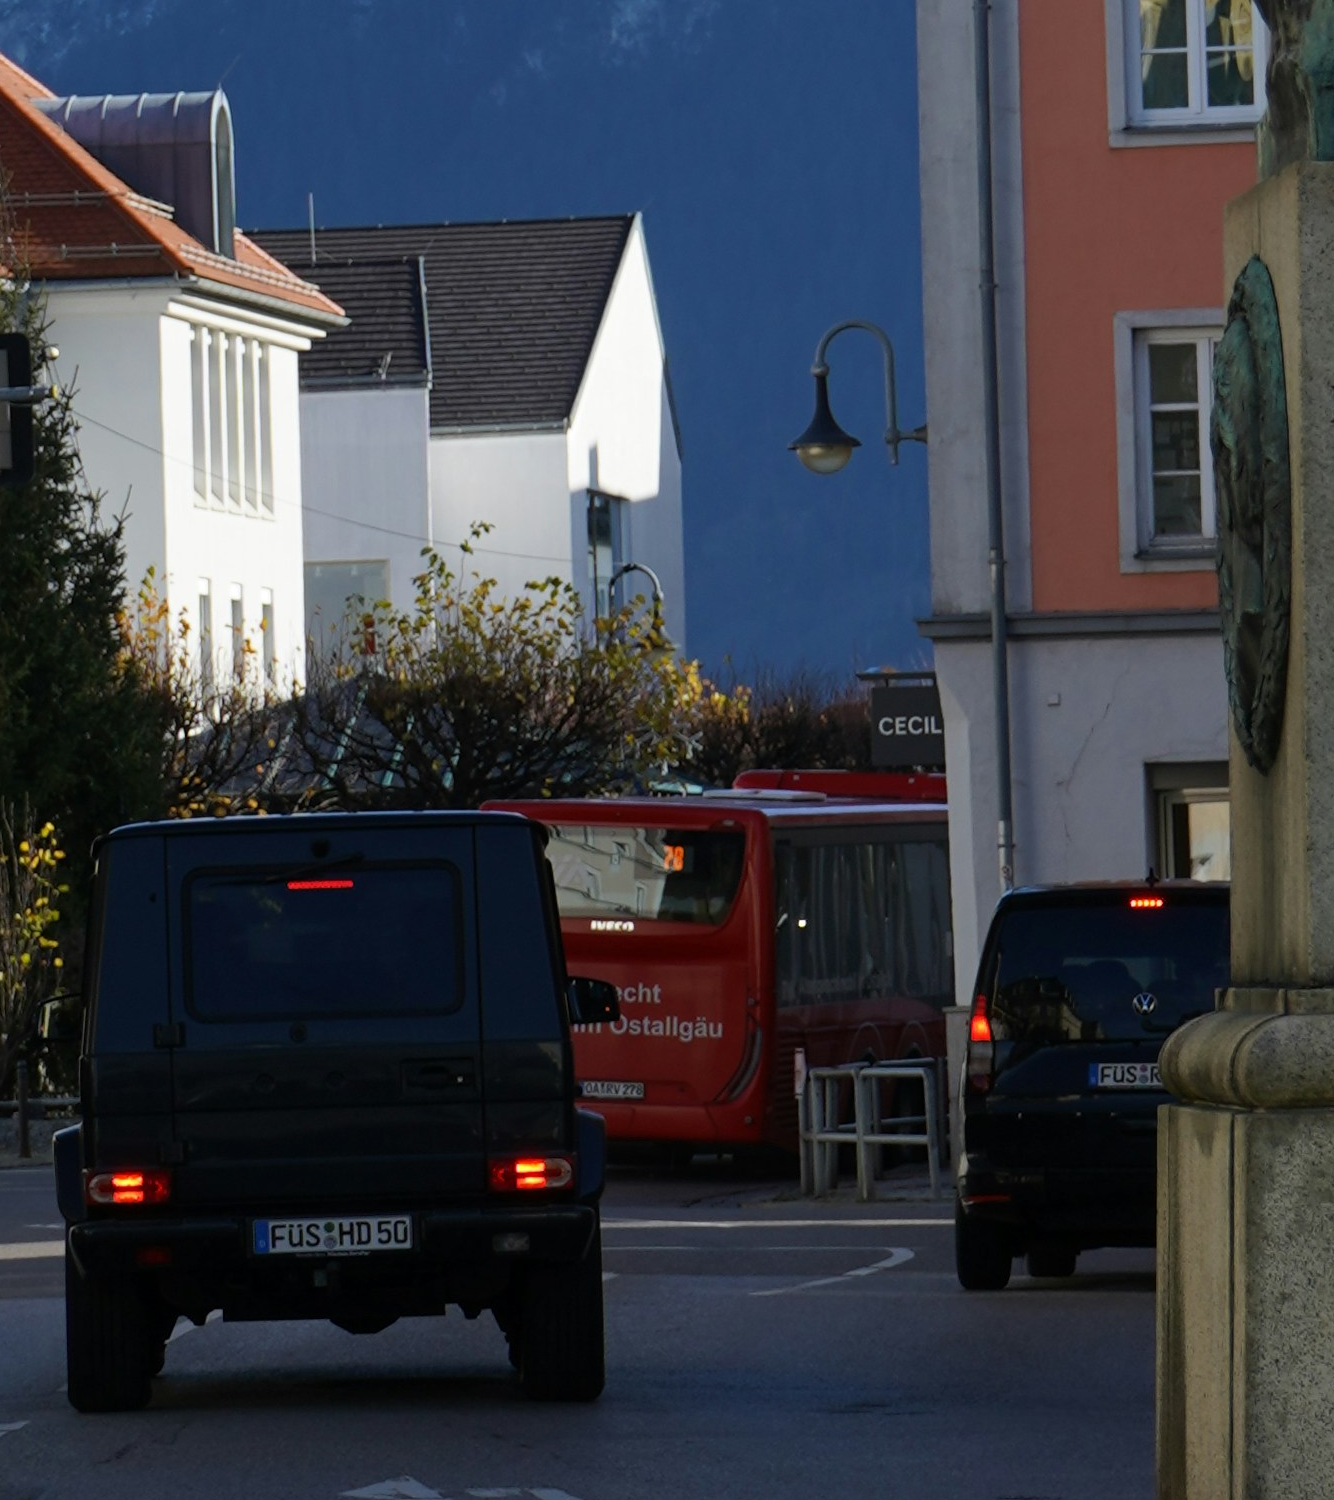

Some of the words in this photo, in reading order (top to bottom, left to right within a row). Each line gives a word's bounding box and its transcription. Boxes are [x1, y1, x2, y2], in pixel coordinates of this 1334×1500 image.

[878, 716, 943, 736] CECIL
[590, 920, 635, 932] IVECO
[610, 1014, 724, 1043] Ostallgäu
[1100, 1065, 1138, 1084] FÜS
[270, 1222, 321, 1249] FÜS
[338, 1221, 372, 1247] HD
[377, 1219, 409, 1245] 50
